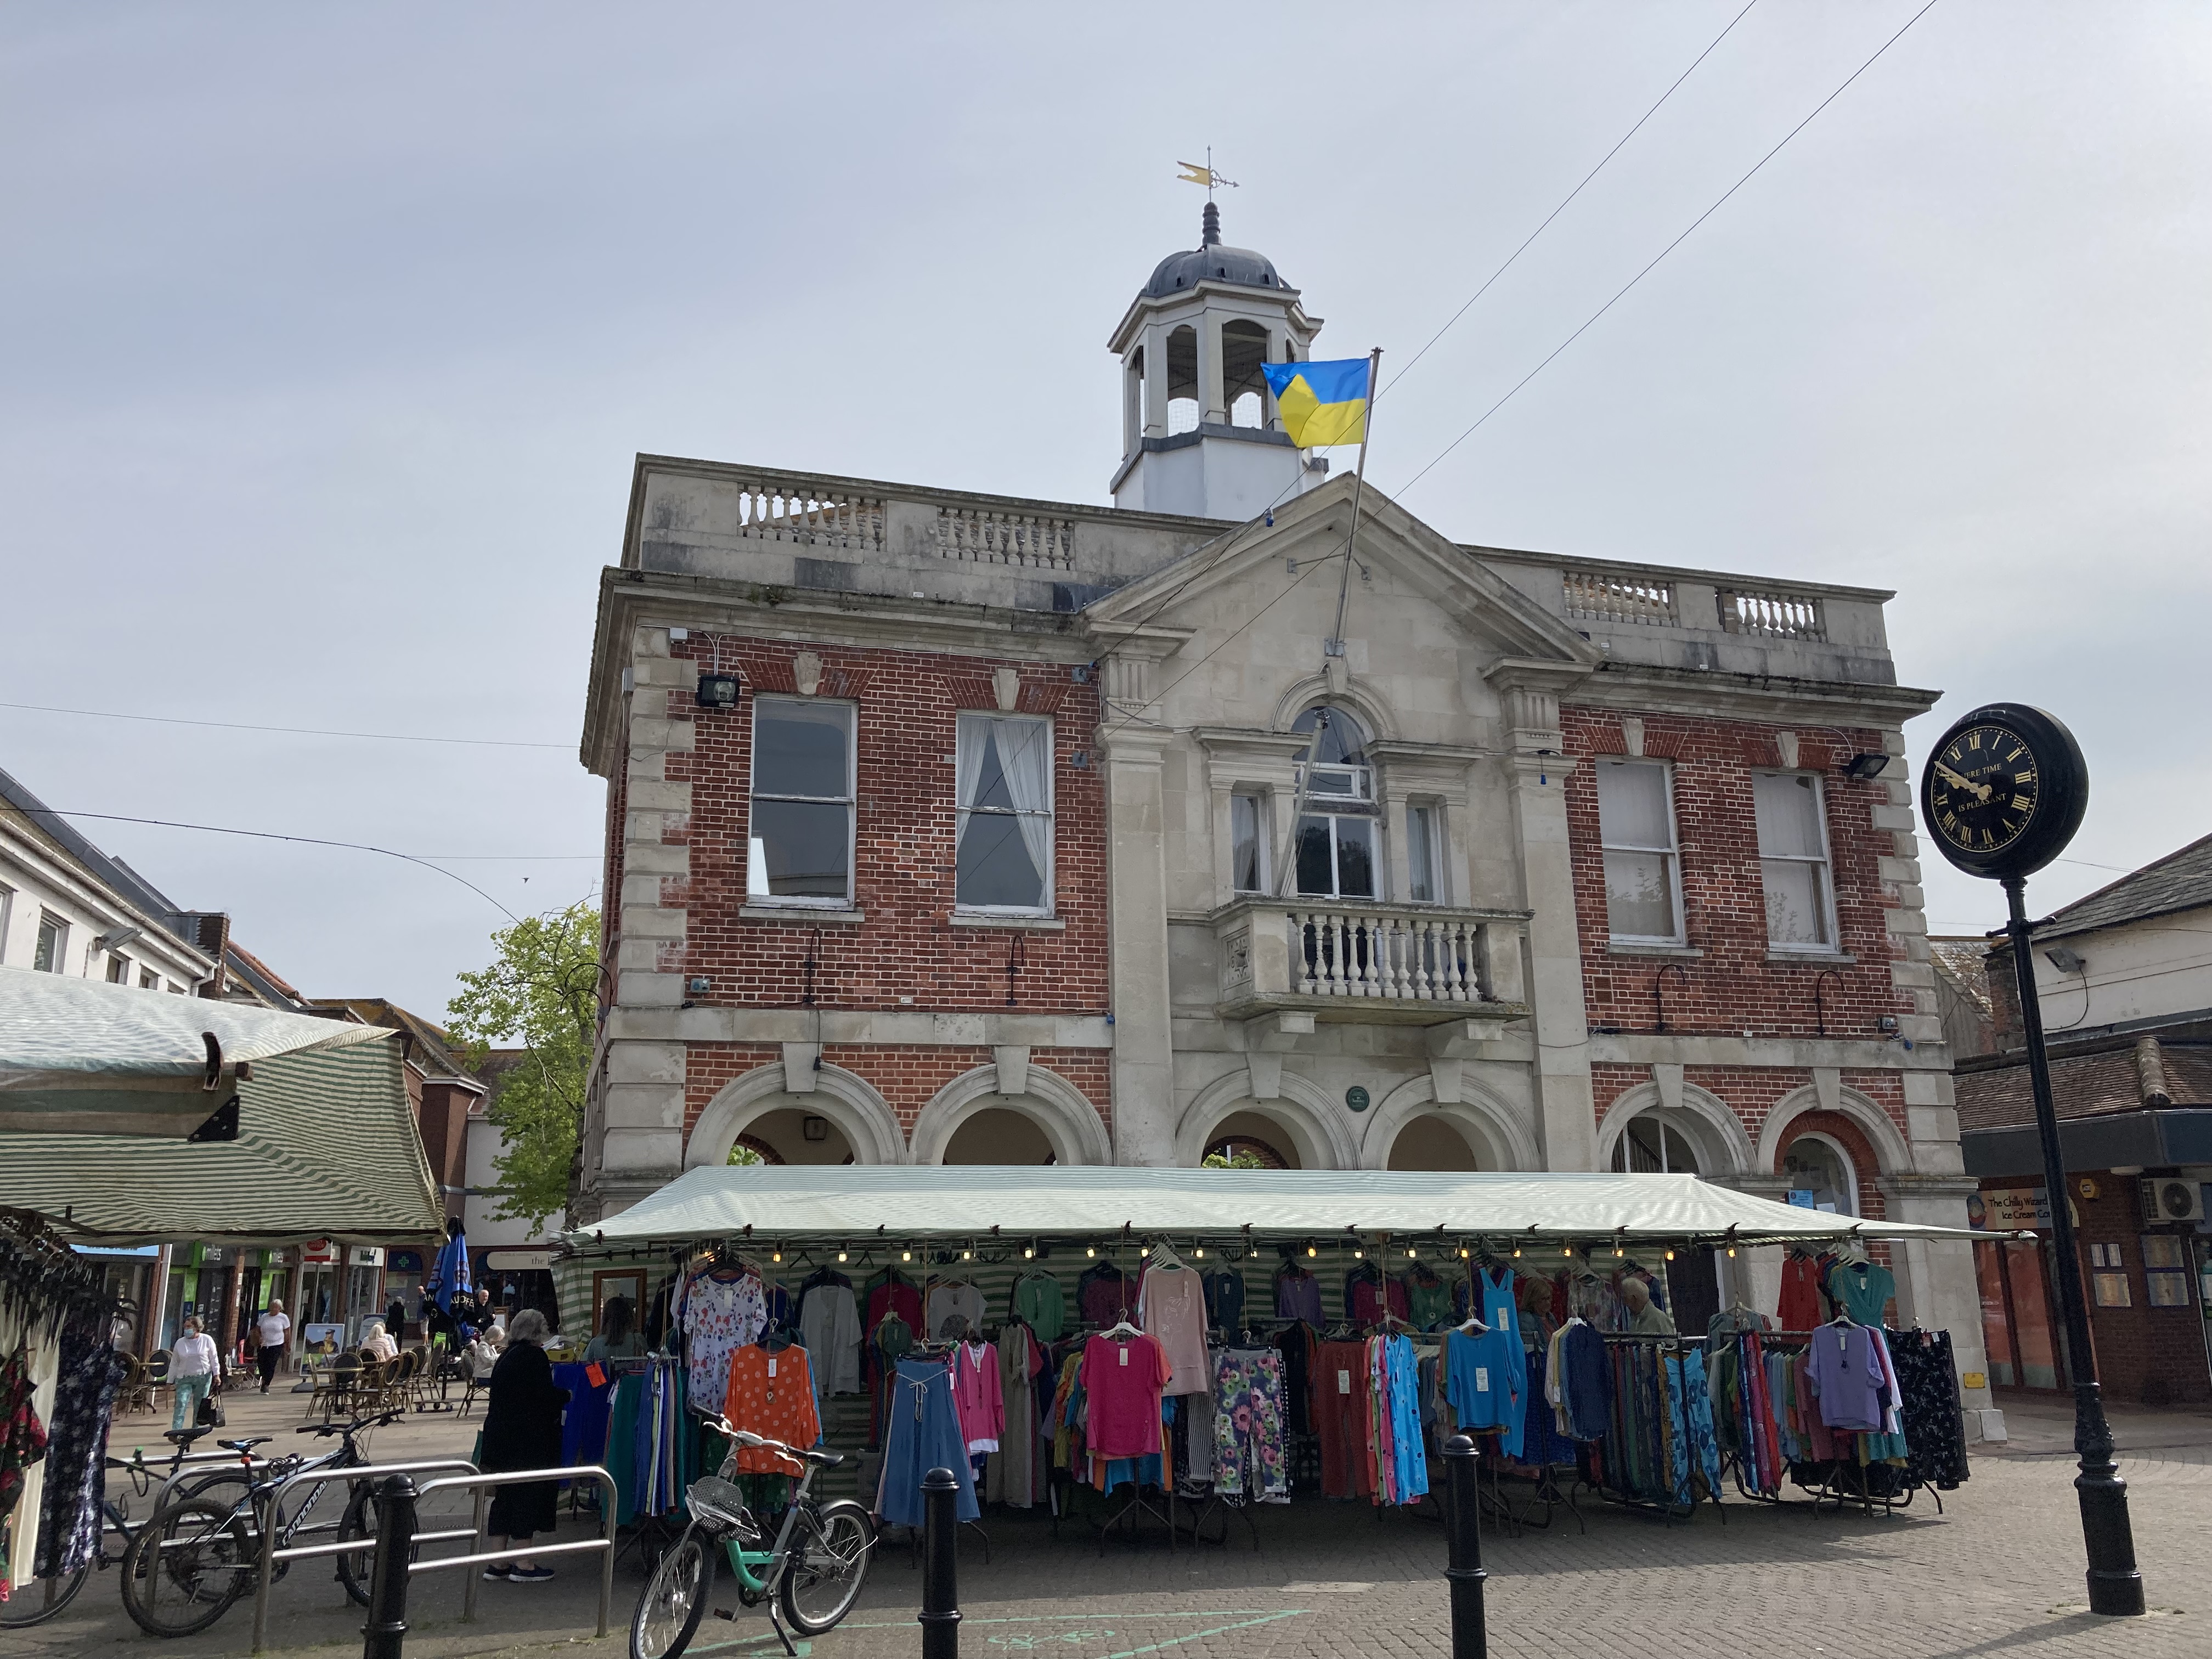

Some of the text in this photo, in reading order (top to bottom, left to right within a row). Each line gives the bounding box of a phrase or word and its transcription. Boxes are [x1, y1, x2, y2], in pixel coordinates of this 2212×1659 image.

[1968, 734, 1981, 752] XII
[1991, 735, 2002, 751] I
[1950, 746, 1963, 764] XI
[2006, 747, 2023, 763] II
[1963, 769, 1980, 779] ERE
[1982, 763, 2002, 775] TIME
[2015, 770, 2032, 785] III
[1958, 793, 2006, 812] IS PLEASANT
[2002, 817, 2016, 833] V
[1961, 825, 1972, 844] VII
[1982, 827, 1995, 845] VI
[1988, 1195, 2002, 1207] The
[2004, 1194, 2023, 1210] Chilly
[2002, 1211, 2013, 1220] Ice
[2013, 1210, 2036, 1219] Cream
[532, 1256, 545, 1265] the
[281, 1480, 330, 1547] CANNONDAL
